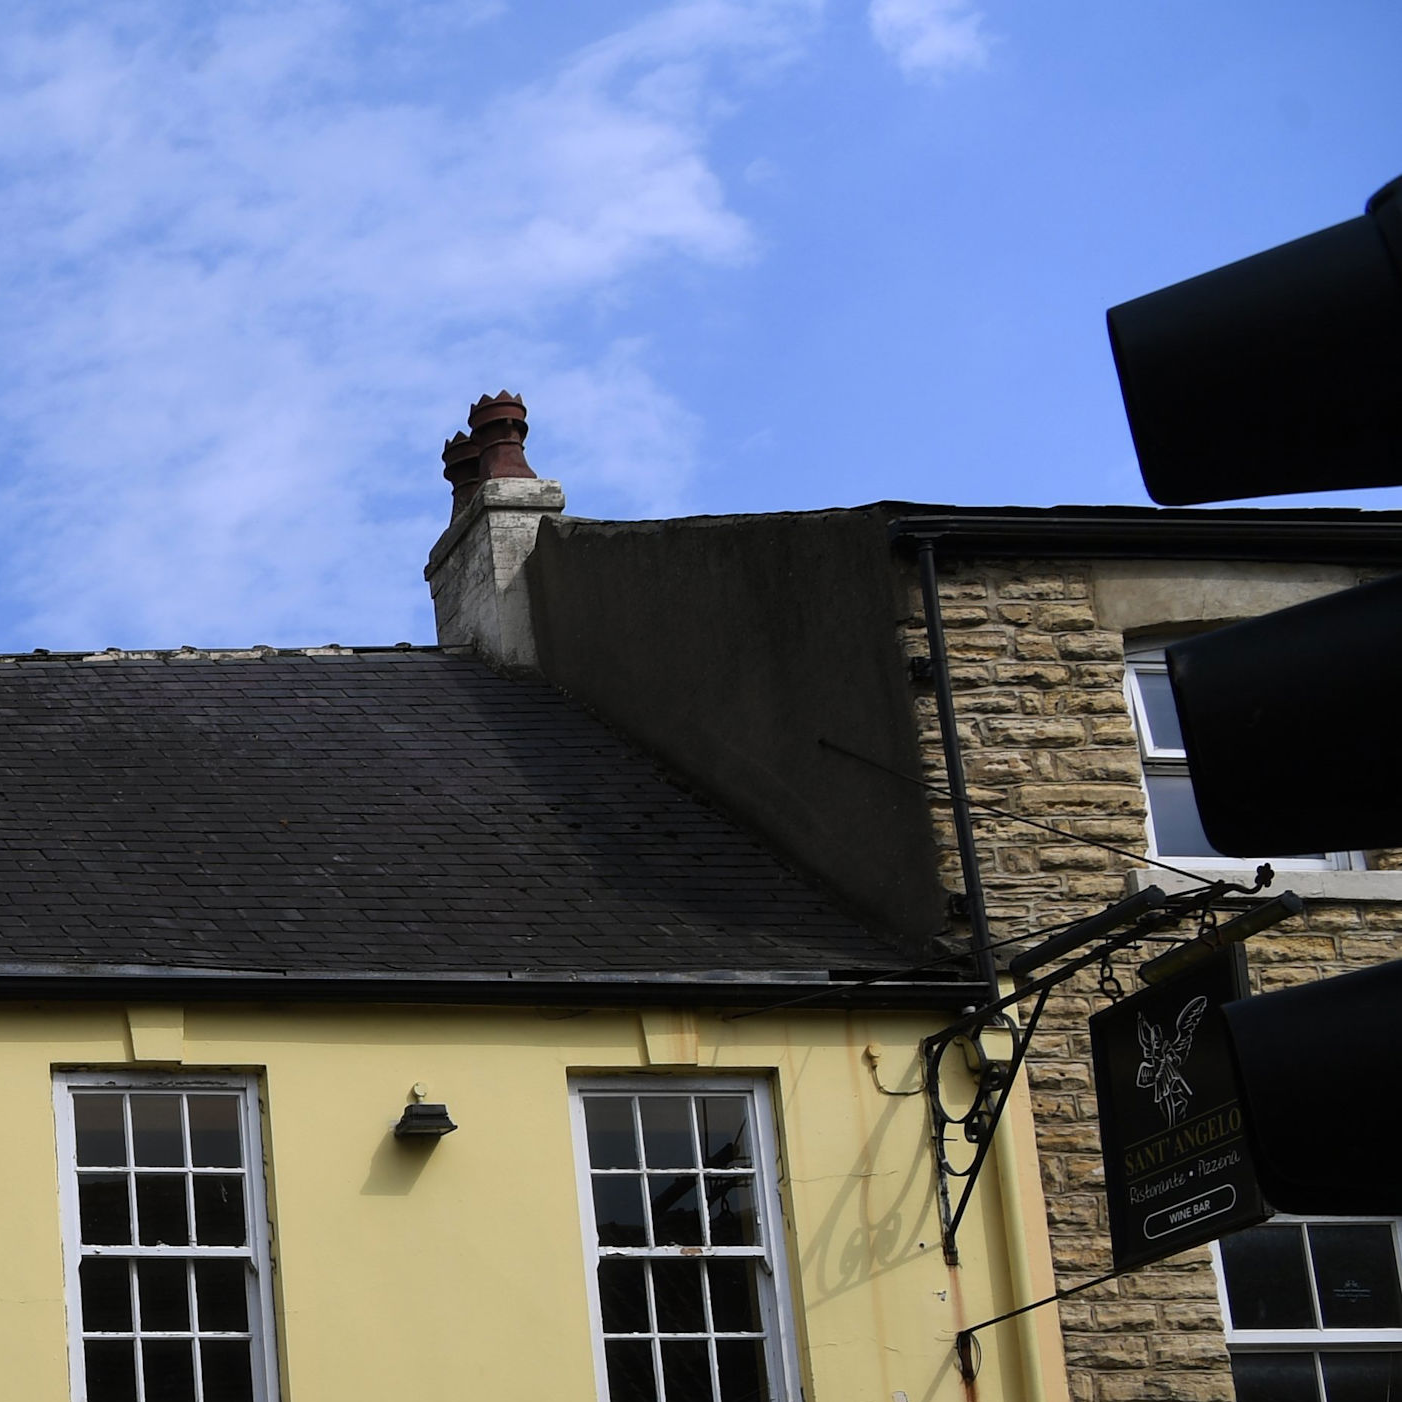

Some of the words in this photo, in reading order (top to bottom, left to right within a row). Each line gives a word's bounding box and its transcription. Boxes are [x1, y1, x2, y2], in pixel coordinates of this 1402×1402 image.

[1129, 1170, 1187, 1206] Ristorante
[1168, 1207, 1193, 1225] WINE
[1192, 1199, 1212, 1215] BAR
